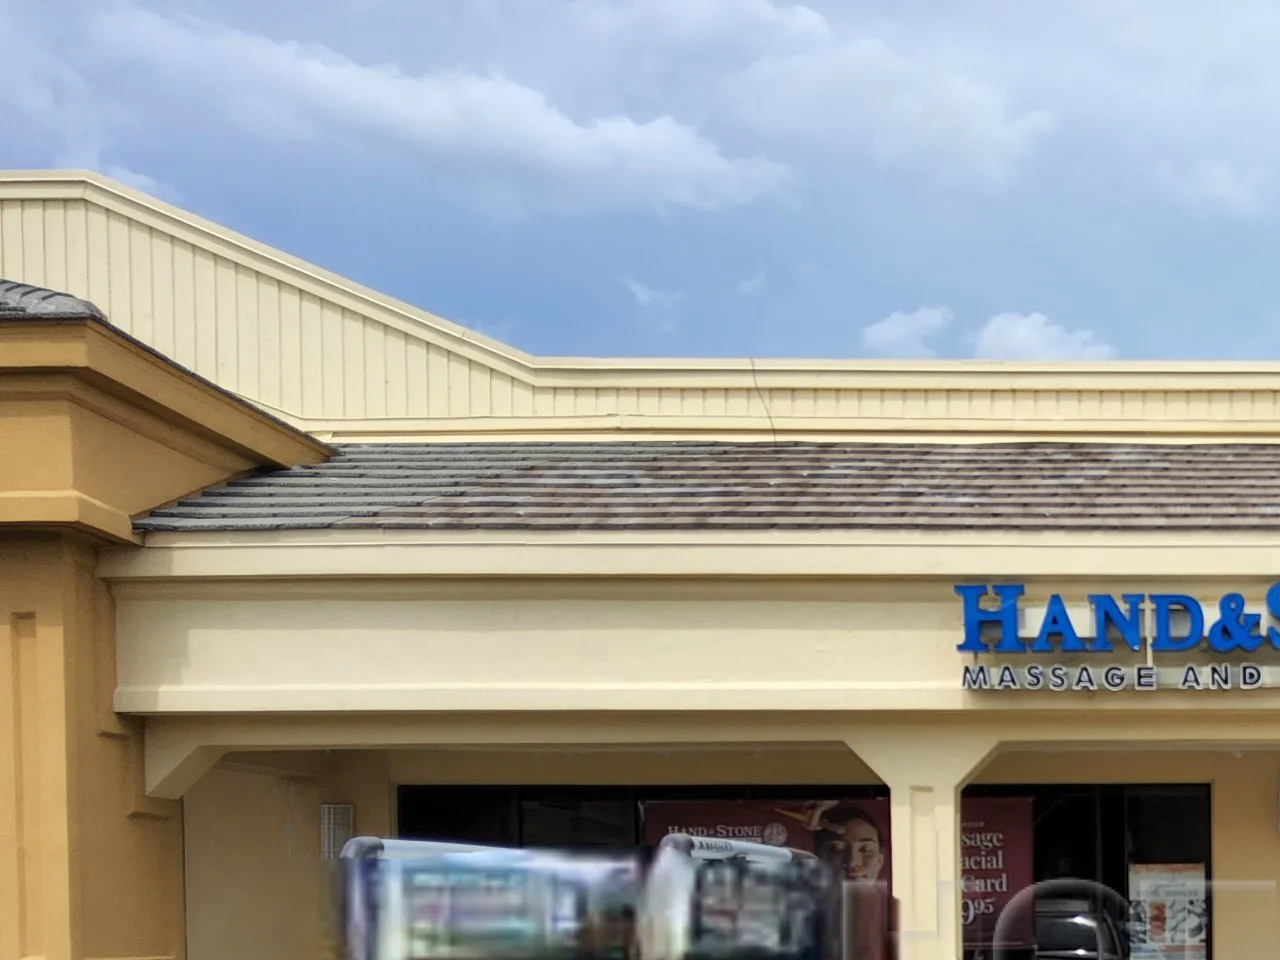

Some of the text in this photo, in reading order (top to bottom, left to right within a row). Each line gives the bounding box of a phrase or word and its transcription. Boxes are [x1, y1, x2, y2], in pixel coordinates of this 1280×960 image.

[960, 664, 1157, 691] MASSAGE
[1180, 663, 1264, 690] AND
[716, 825, 762, 837] STONE
[961, 832, 1004, 849] sage
[960, 850, 1004, 869] acial
